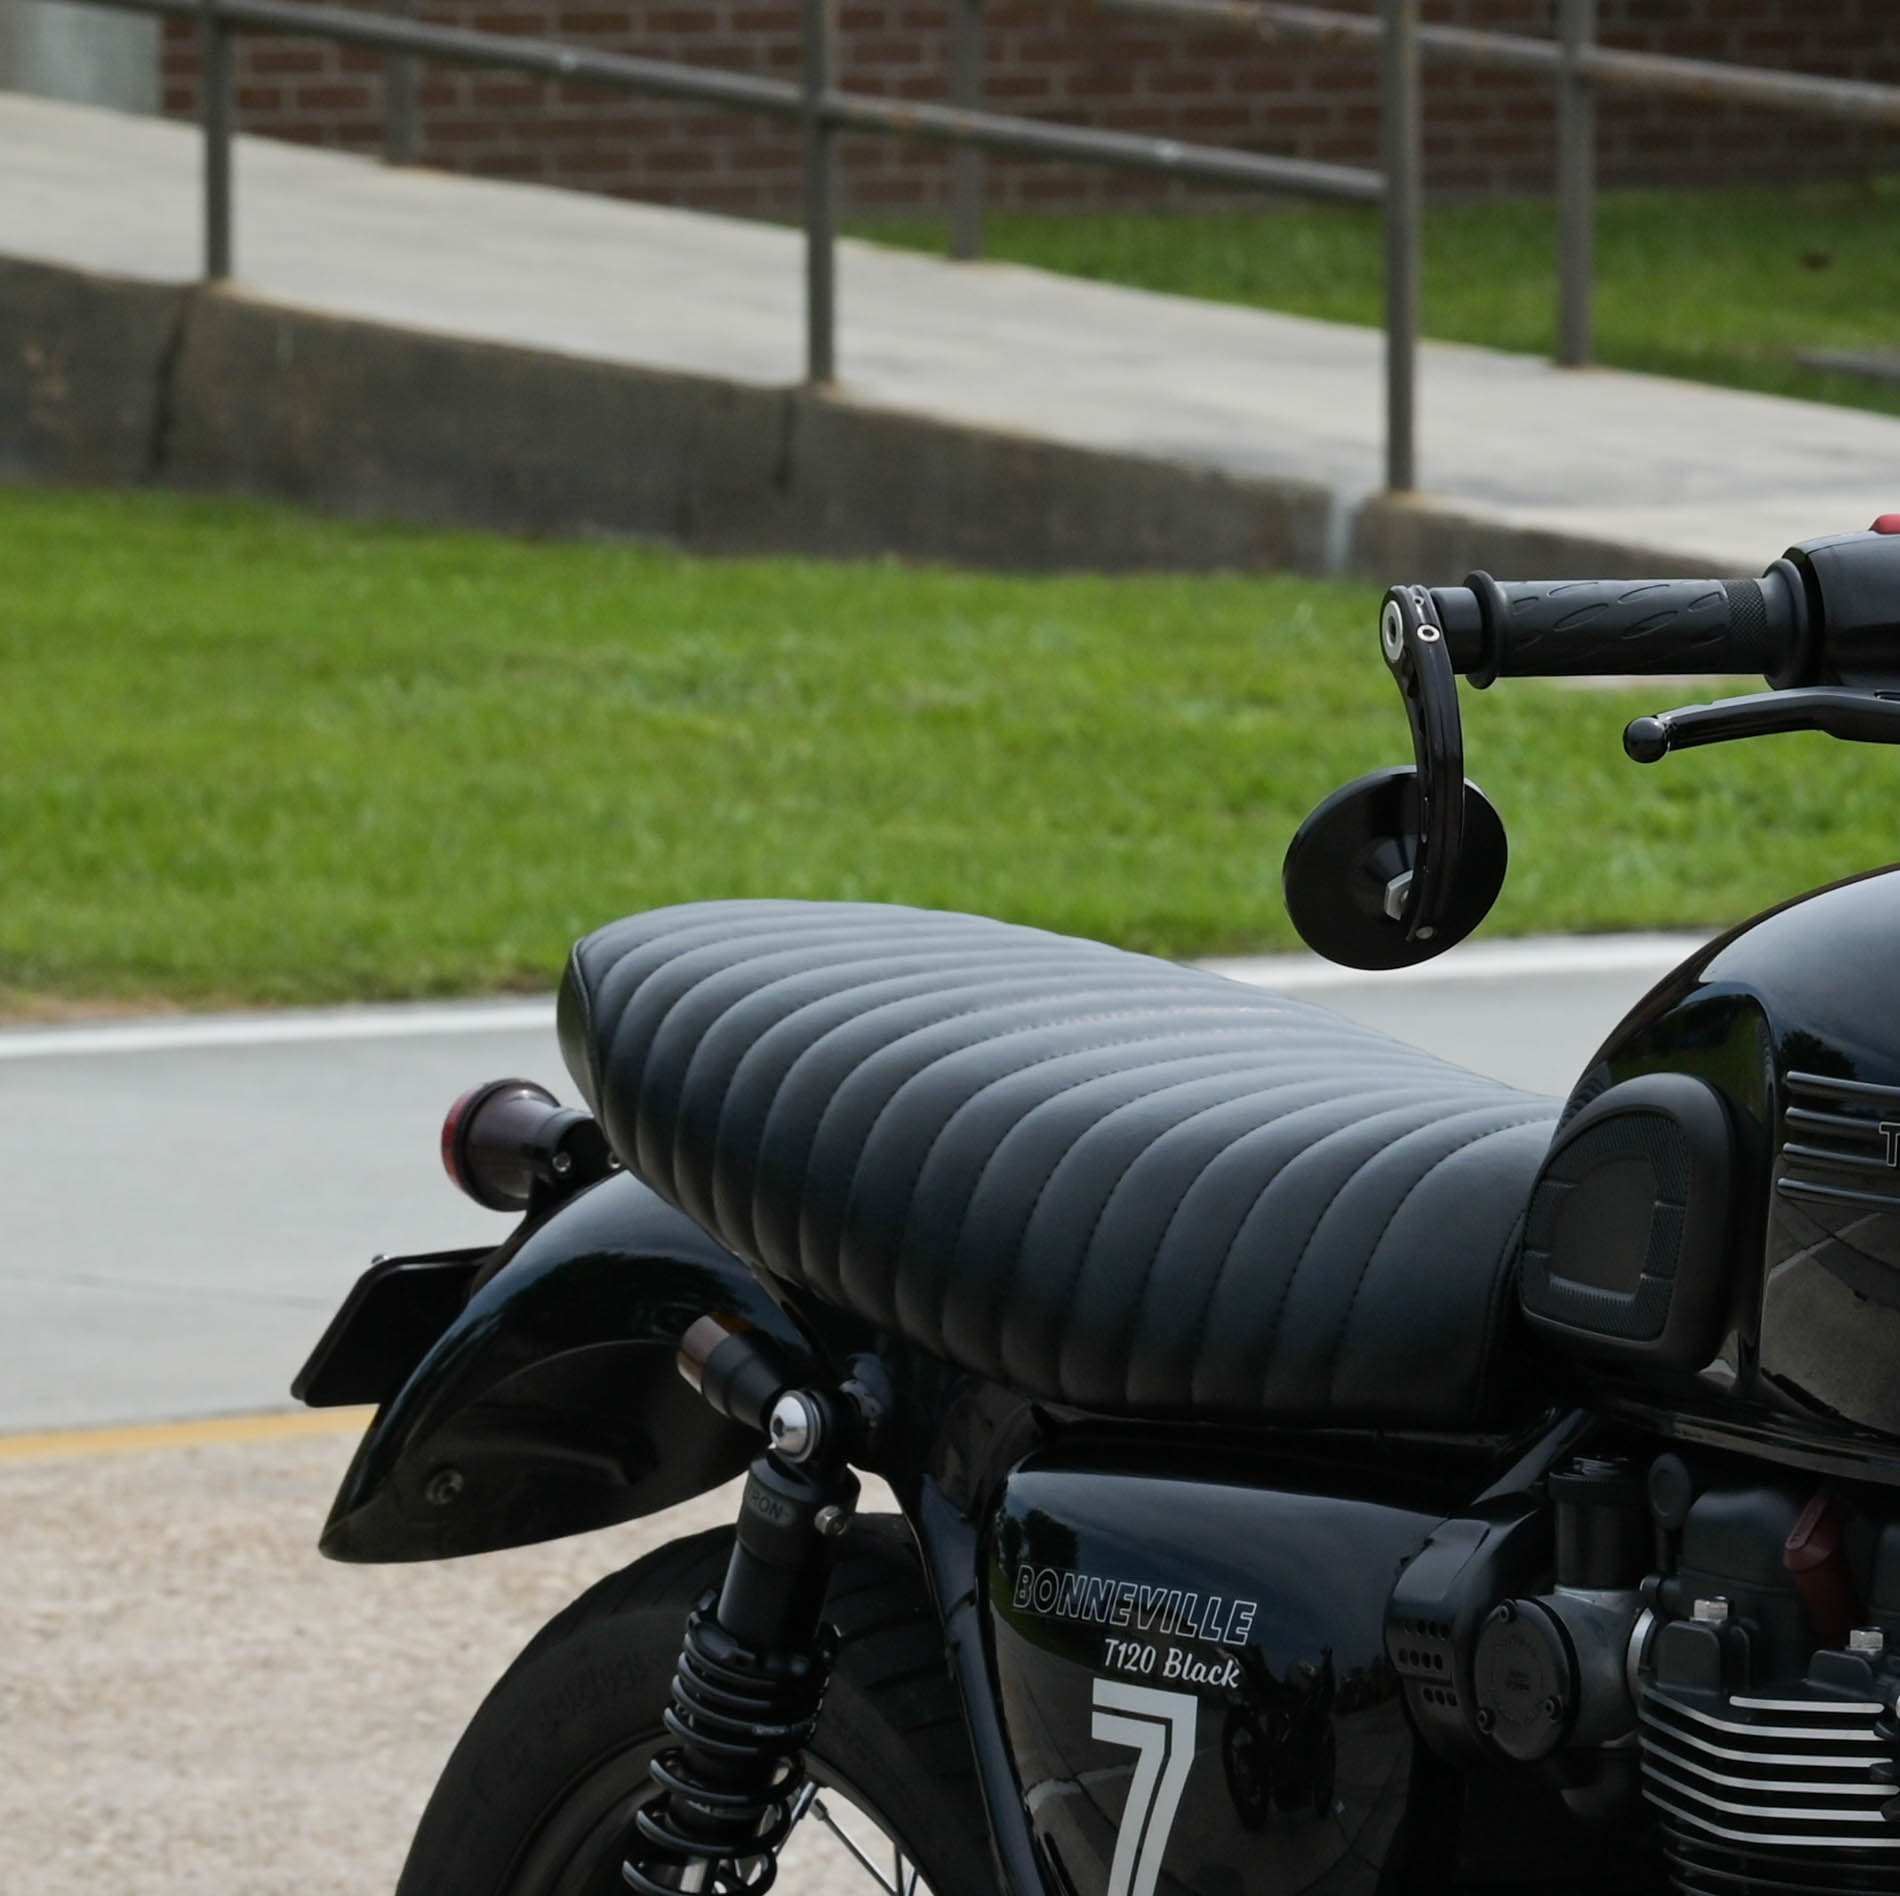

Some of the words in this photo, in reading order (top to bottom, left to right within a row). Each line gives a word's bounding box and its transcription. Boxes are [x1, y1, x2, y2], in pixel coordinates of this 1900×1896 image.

[1012, 1563, 1258, 1645] BONNEVILLE
[1105, 1638, 1156, 1675] T120
[1163, 1648, 1241, 1690] Black
